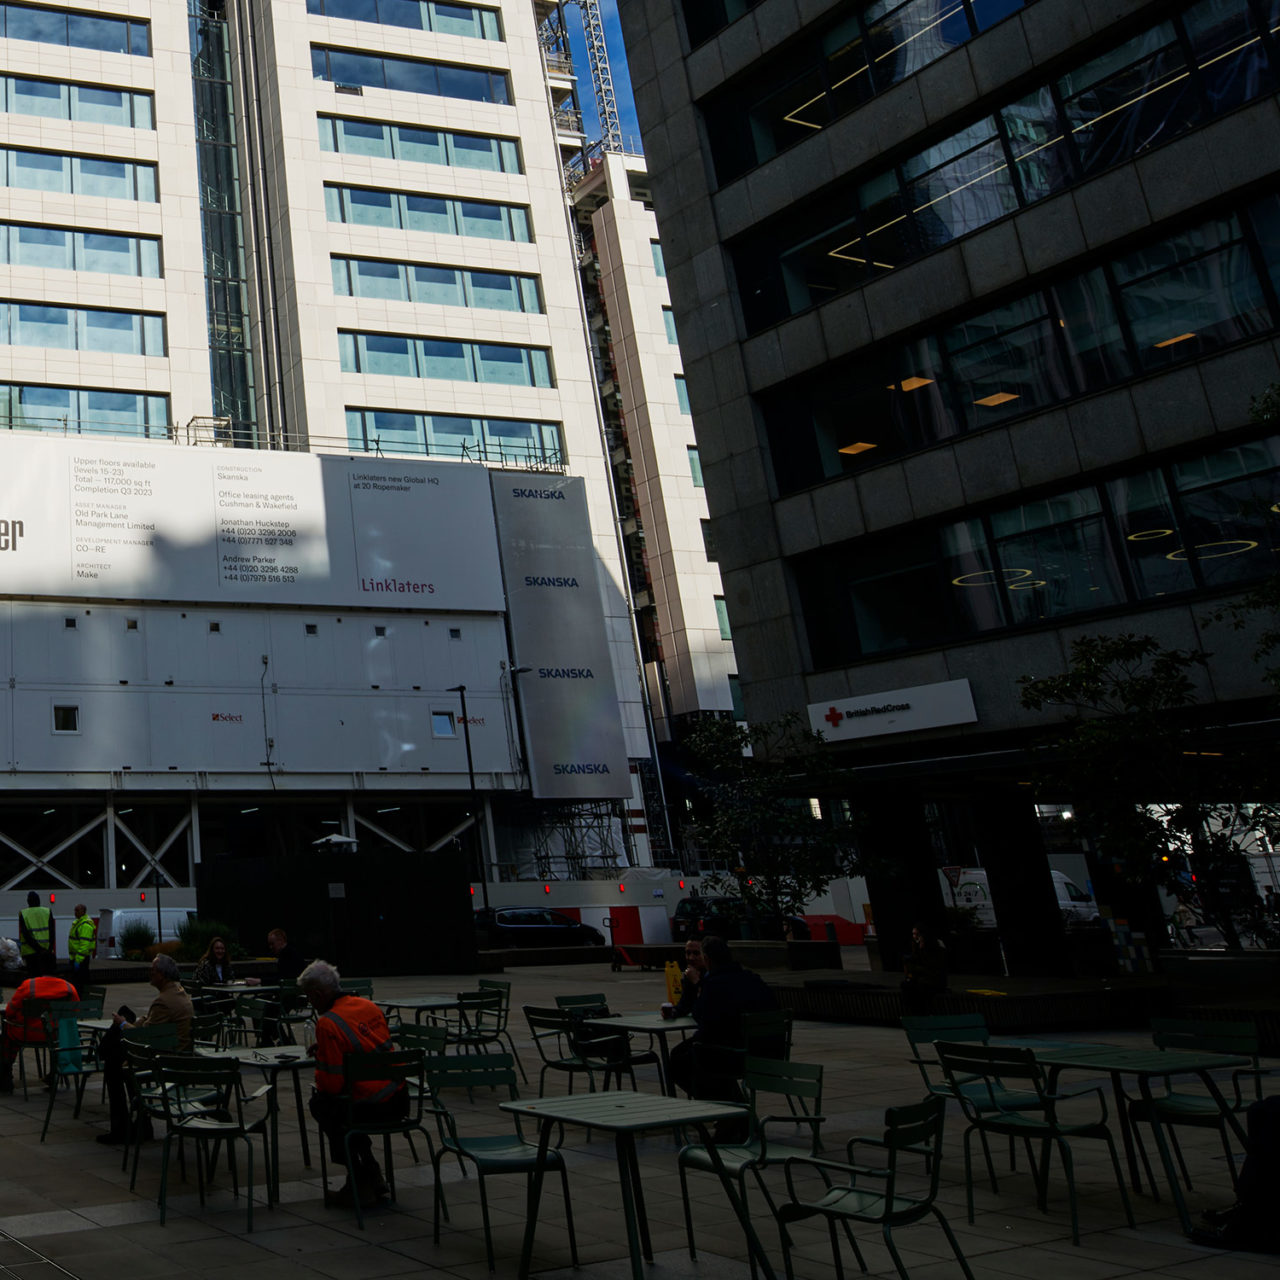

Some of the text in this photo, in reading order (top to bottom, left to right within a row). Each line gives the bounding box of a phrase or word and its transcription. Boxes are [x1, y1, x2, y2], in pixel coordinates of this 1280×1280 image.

[74, 457, 156, 470] Upper floors available
[74, 466, 124, 477] (levels 15-23)
[216, 465, 262, 473] CONSTRUCTION
[74, 475, 93, 483] Total
[217, 473, 249, 481] Skanska
[352, 473, 387, 482] Linklaters
[403, 476, 426, 484] Global
[427, 477, 439, 485] HQ
[74, 484, 153, 497] Completion Q3 2023
[372, 483, 411, 492] Ropemaker
[218, 491, 294, 502] Office leasing agents
[512, 488, 565, 501] SKANSKA
[96, 503, 127, 511] MANAGER
[219, 500, 298, 510] Cushman & Wakefield
[75, 509, 129, 520] Old Park Lane
[75, 519, 156, 531] Management Limited
[220, 518, 290, 529] Jonathan Huckstep
[221, 527, 235, 535] +44
[237, 528, 256, 536] (0)20
[75, 536, 154, 547] DEVELOPMENT MANAGER
[222, 536, 236, 544] +44
[222, 555, 276, 564] Andrew Parker
[76, 562, 112, 570] ARCHITECT
[223, 564, 238, 572] +44
[239, 565, 259, 573] (0)20
[76, 570, 99, 579] Make
[362, 578, 435, 595] Linklaters
[525, 576, 579, 588] SKANSKA
[538, 668, 594, 680] SKANSKA
[219, 713, 242, 722] Select
[464, 716, 485, 725] elect
[553, 763, 610, 775] SKANSKA
